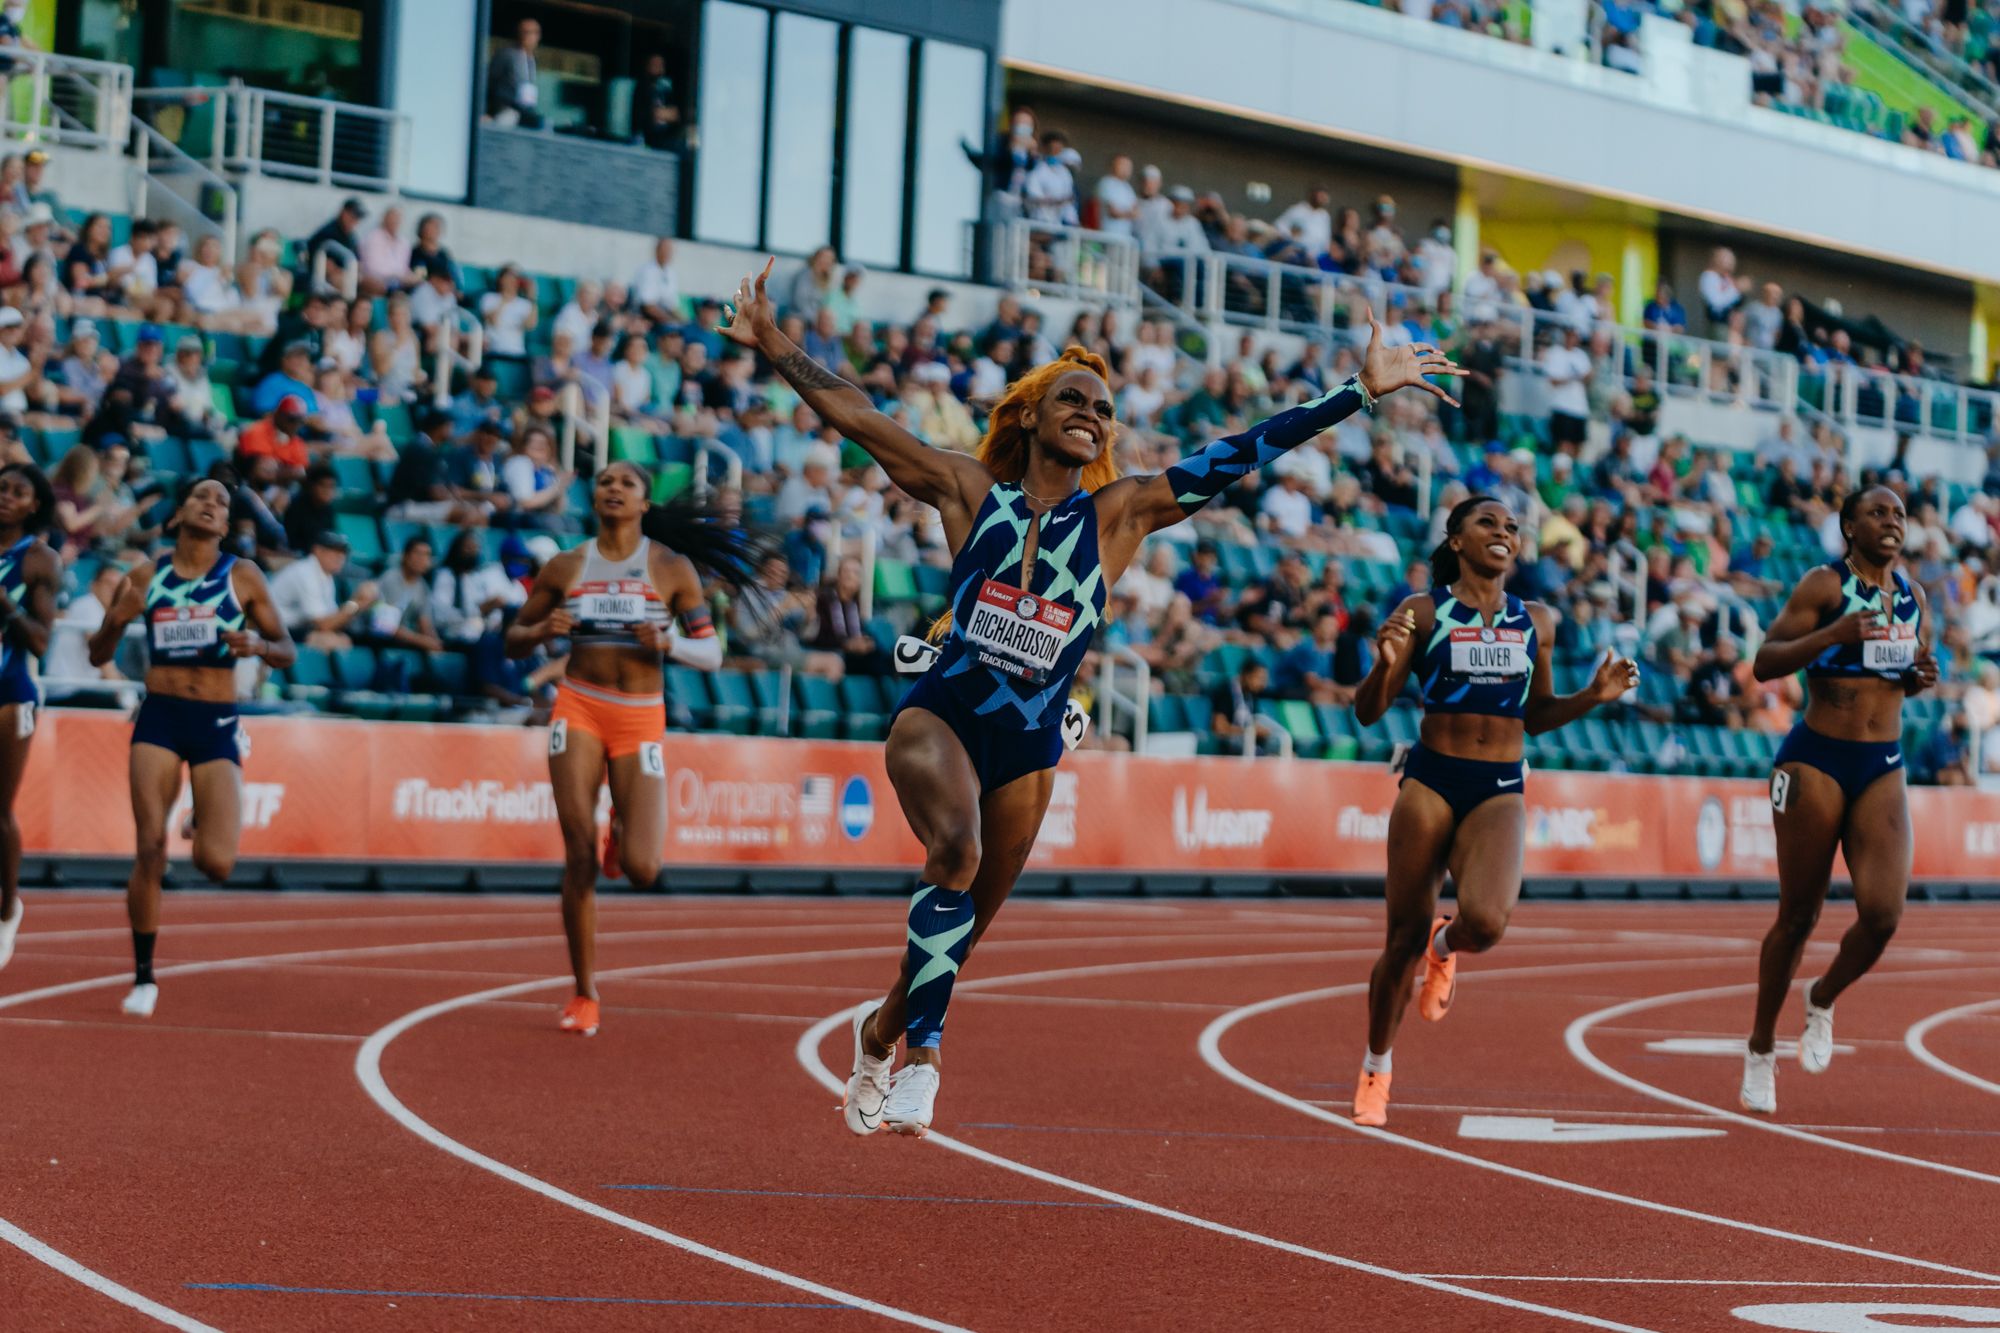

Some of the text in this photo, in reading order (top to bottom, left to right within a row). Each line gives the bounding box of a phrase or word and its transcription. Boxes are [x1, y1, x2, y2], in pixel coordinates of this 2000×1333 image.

[593, 598, 634, 614] THOMAS
[163, 623, 208, 642] GARDNER
[971, 609, 1061, 663] RICHARDSON
[1470, 647, 1510, 667] OLIVER
[552, 721, 562, 750] 6
[1065, 706, 1085, 742] 5
[649, 744, 661, 771] 6
[1774, 774, 1786, 806] 3
